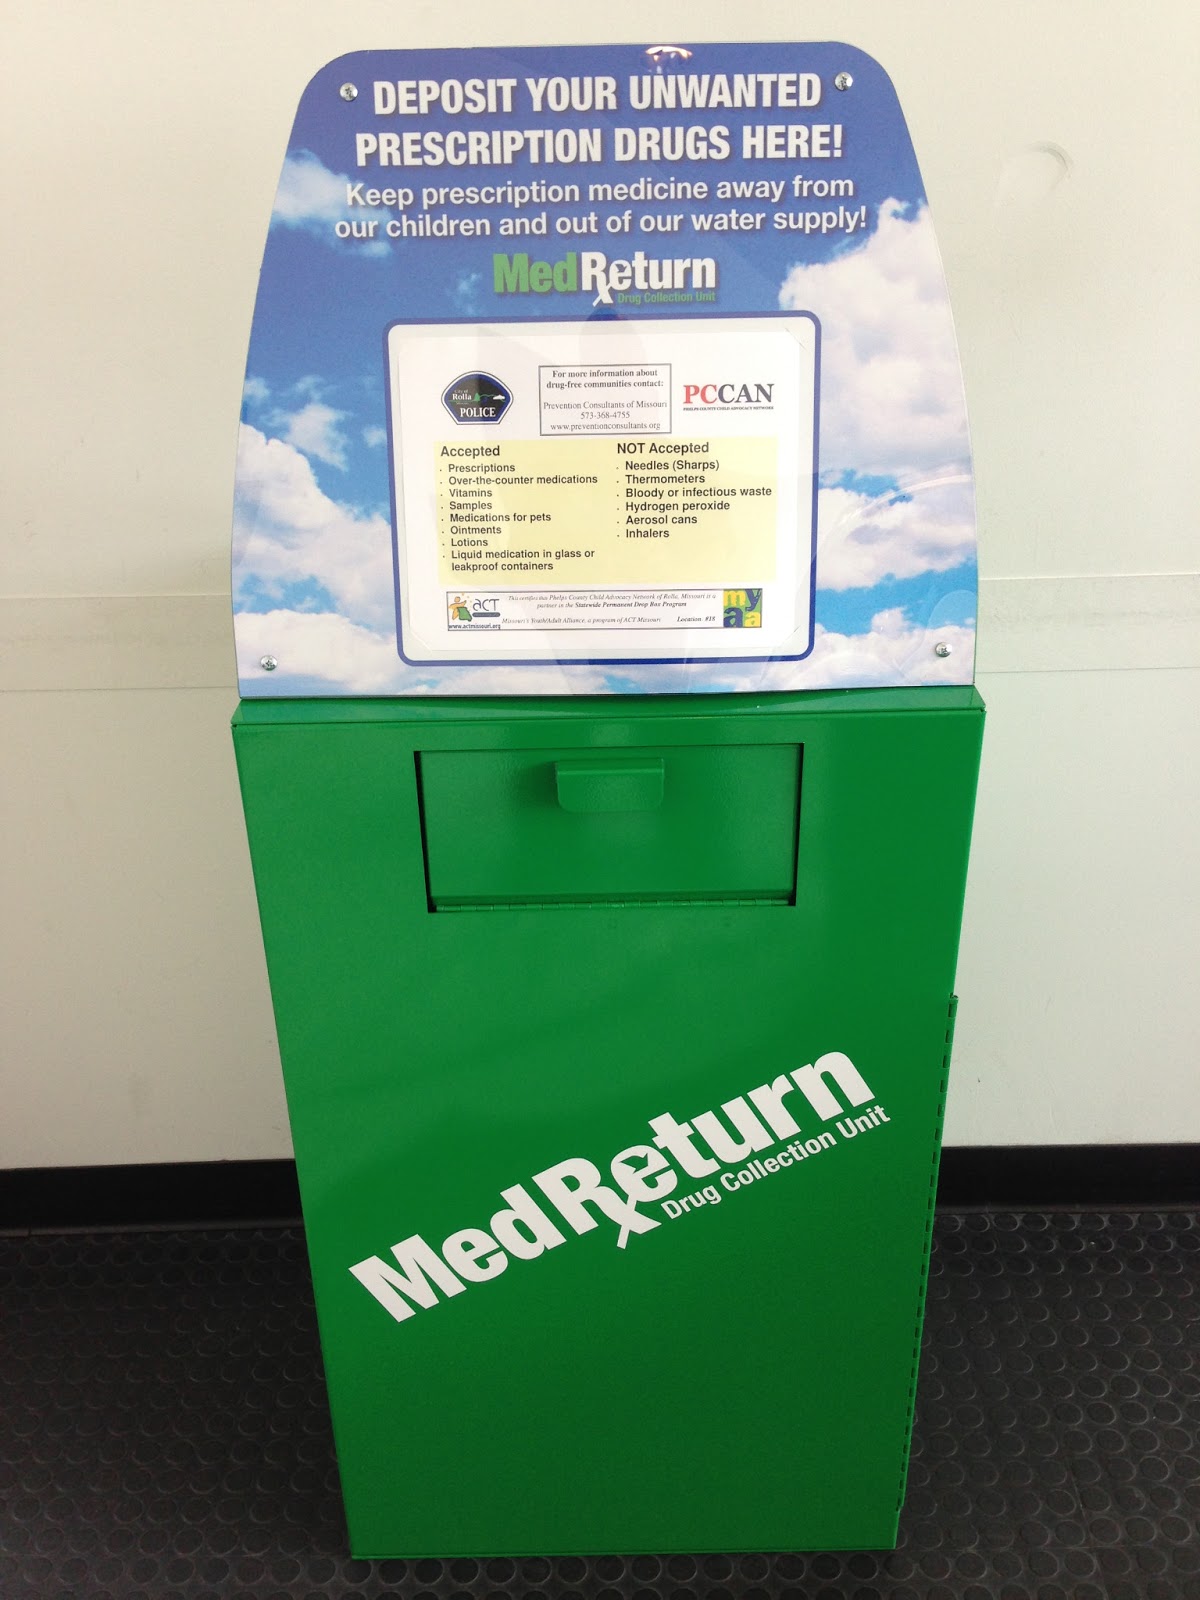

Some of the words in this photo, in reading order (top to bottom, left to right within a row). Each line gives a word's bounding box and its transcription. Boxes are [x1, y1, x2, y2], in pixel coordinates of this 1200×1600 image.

[373, 79, 518, 115] DEPOSIT
[526, 75, 617, 112] YOUR
[629, 73, 821, 109] UNWANTED
[355, 128, 601, 167] PRESCRIPTION
[615, 126, 731, 161] DRUGS
[742, 124, 843, 159] HERE!
[346, 184, 414, 209] Keep
[422, 180, 580, 208] prescription
[588, 178, 708, 201] medicine
[716, 180, 783, 203] away
[792, 176, 854, 197] from
[334, 219, 378, 238] our
[386, 214, 491, 237] children
[499, 213, 547, 235] and
[555, 214, 598, 234] out
[605, 212, 632, 233] of
[639, 213, 683, 232] our
[690, 210, 765, 231] water
[773, 206, 866, 233] supply!
[618, 293, 641, 304] Drug
[644, 292, 692, 302] Collection
[696, 292, 715, 301] Unit
[590, 369, 634, 377] information
[546, 381, 582, 389] drug-free
[584, 380, 631, 388] communities
[683, 384, 774, 404] PCCAN
[583, 401, 624, 409] Consultants
[636, 400, 667, 408] Missouri
[460, 407, 496, 417] POLICE
[580, 411, 630, 419] 573-368-4755
[551, 422, 660, 431] www.preventionconsultants.org
[440, 445, 500, 459] Accepted
[617, 443, 645, 454] NOT
[649, 442, 710, 456] Accepted
[448, 463, 516, 474] Prescriptions
[625, 461, 669, 470] Needles
[672, 460, 719, 472] (Sharps)
[448, 476, 533, 485] Over-the-counter
[536, 475, 598, 484] medications
[626, 474, 705, 484] Thermometers
[449, 488, 492, 497] Vitamins
[626, 488, 664, 499] Bloody
[667, 489, 679, 497] or
[682, 487, 737, 497] infectious
[740, 487, 772, 496] waste
[449, 501, 492, 511] Samples
[626, 502, 679, 513] Hydrogen
[682, 500, 730, 512] peroxide
[450, 513, 510, 522] Medications
[513, 513, 527, 521] for
[530, 513, 552, 524] pets
[626, 515, 668, 525] Aerosol
[671, 516, 698, 524] cans
[450, 526, 502, 534] Ointments
[626, 529, 670, 538] Inhalers
[451, 538, 488, 547] Lotions
[452, 550, 482, 560] Liquid
[485, 549, 540, 559] medication
[543, 549, 552, 558] in
[555, 549, 582, 560] glass
[452, 562, 498, 572] leakproof
[501, 561, 554, 571] containers
[662, 600, 687, 608] Program
[660, 1181, 722, 1220] Drug
[719, 1127, 838, 1190] Collection
[836, 1103, 891, 1140] Unit
